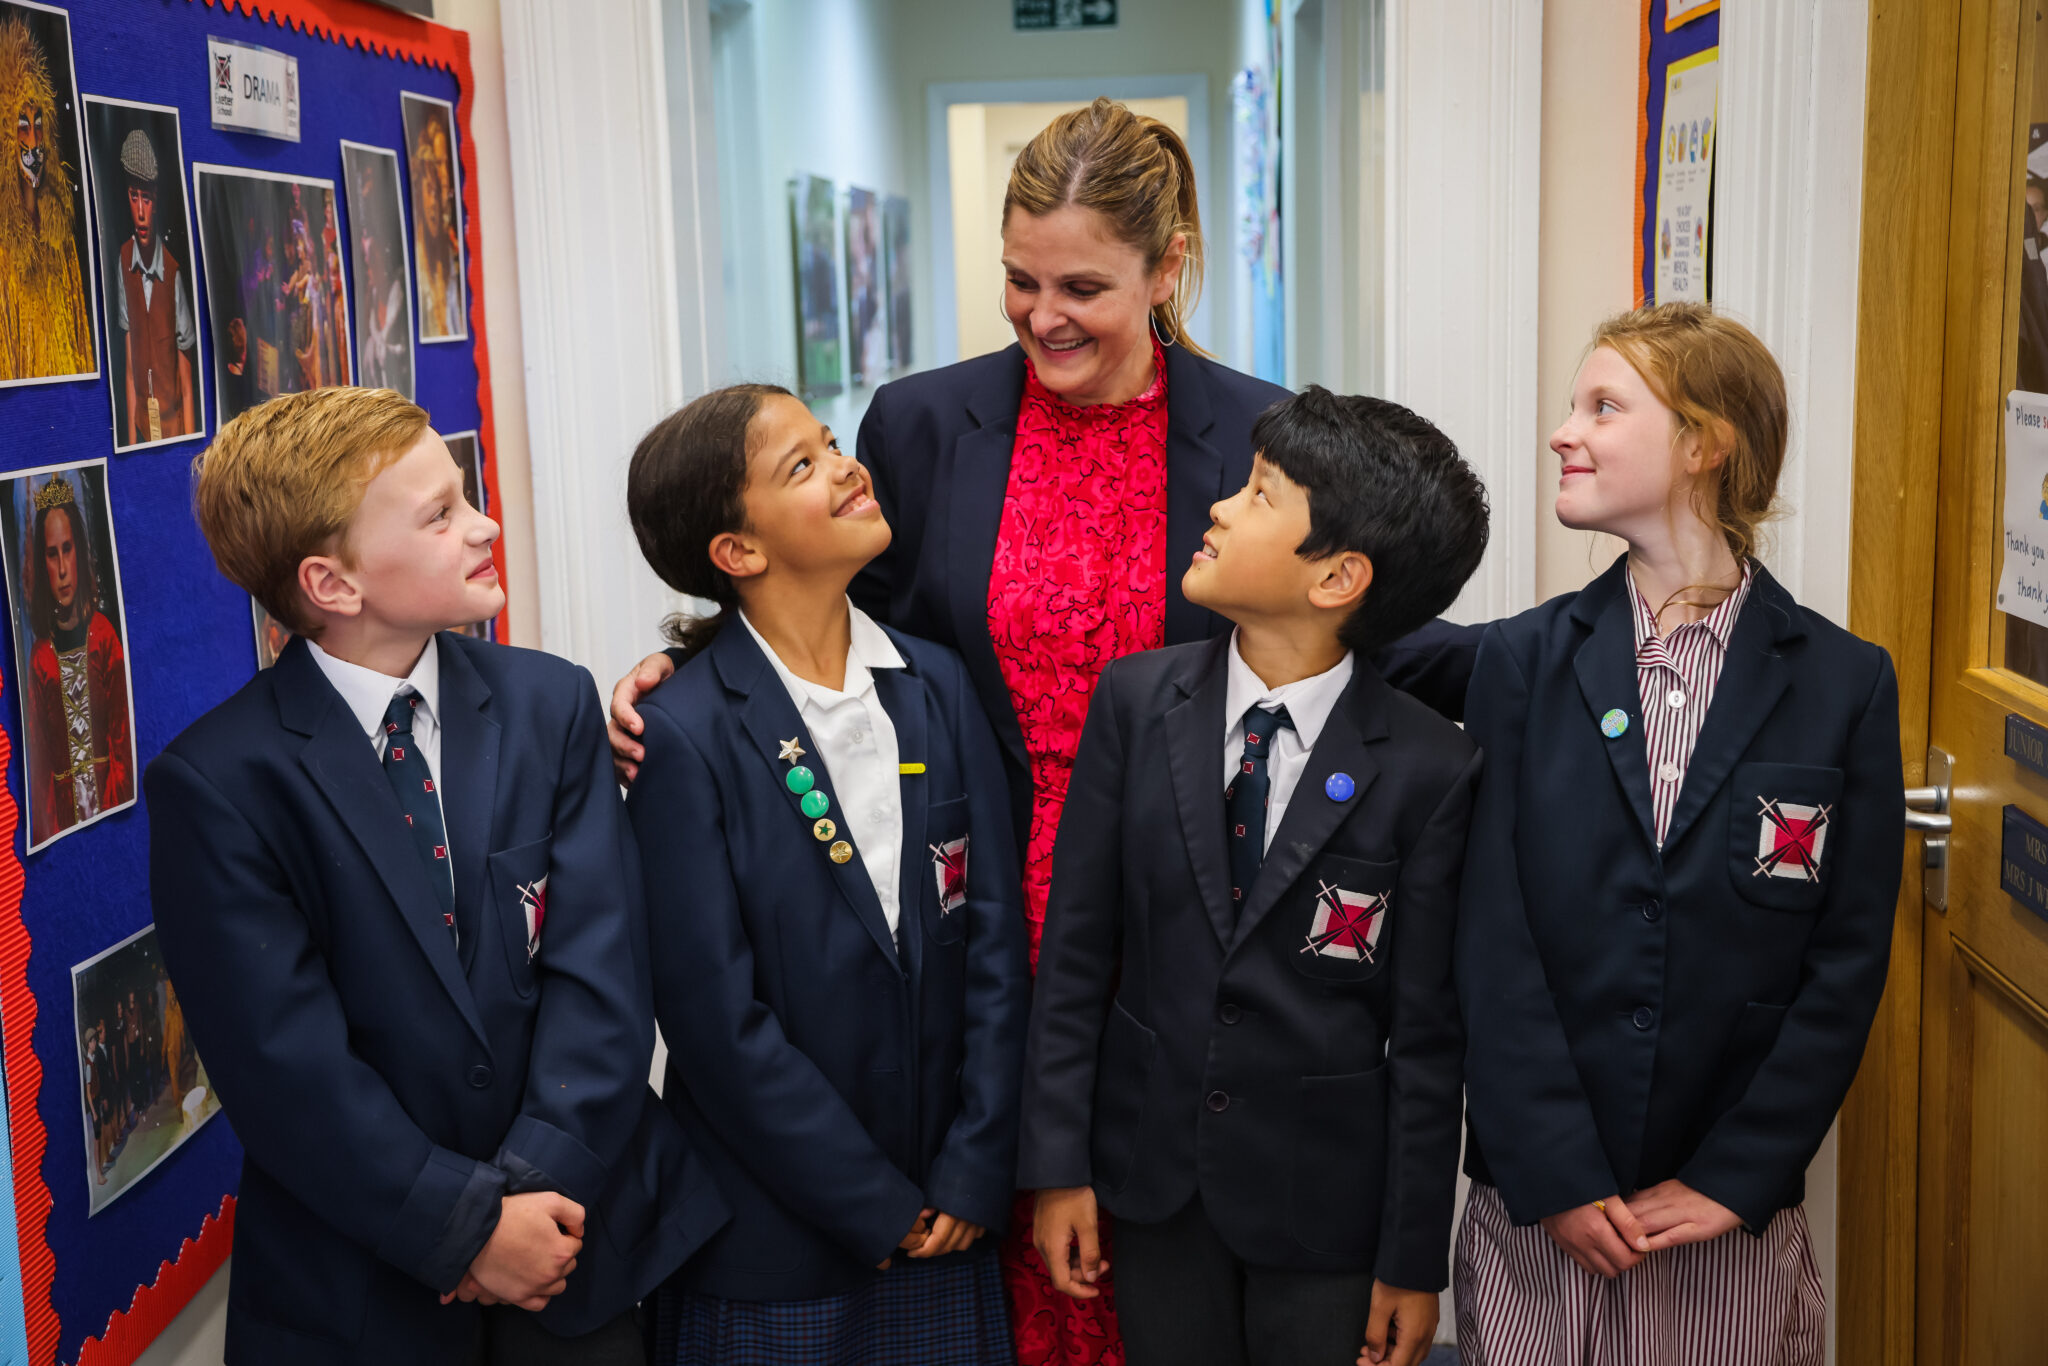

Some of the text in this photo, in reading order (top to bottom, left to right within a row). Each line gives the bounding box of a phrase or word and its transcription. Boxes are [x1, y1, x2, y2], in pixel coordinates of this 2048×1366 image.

[243, 74, 281, 106] DRAMA
[2015, 404, 2041, 428] Please
[2006, 529, 2045, 567] Thank you
[2018, 575, 2042, 602] thank
[2009, 726, 2044, 767] JUNIOR
[2026, 832, 2047, 865] MRS
[2004, 858, 2025, 891] MRS
[2028, 877, 2033, 896] J
